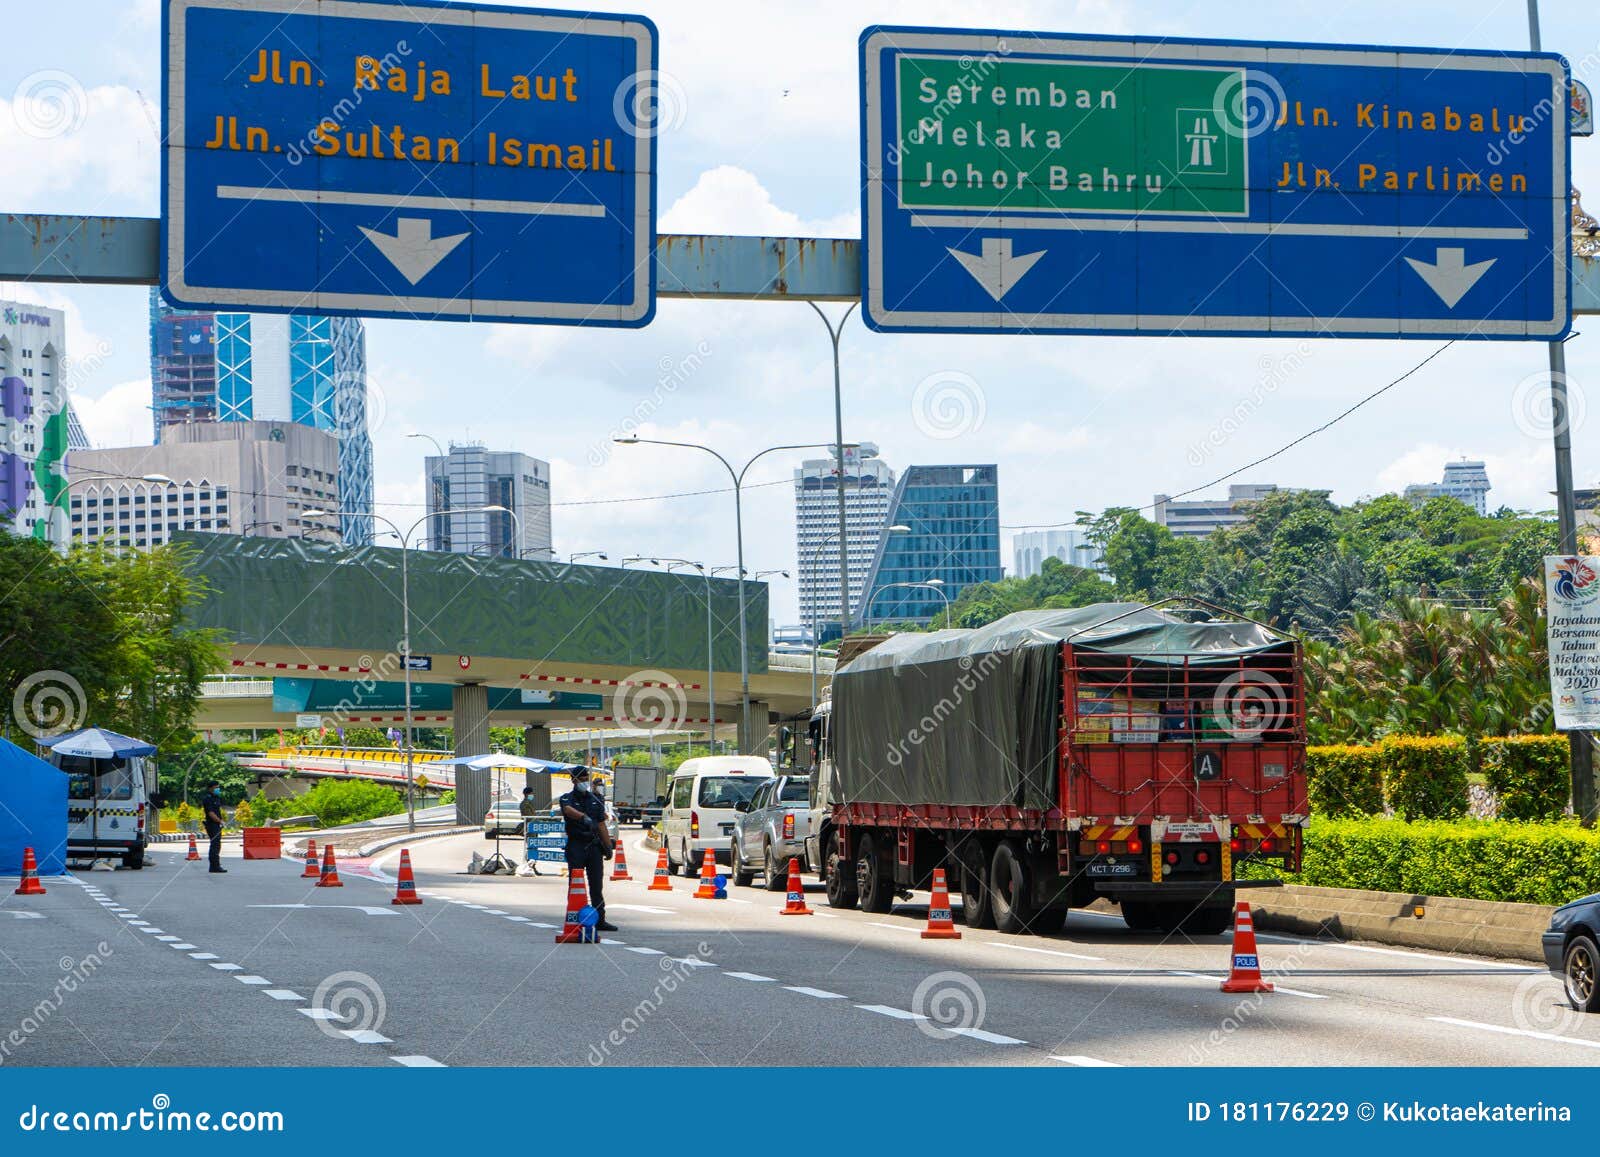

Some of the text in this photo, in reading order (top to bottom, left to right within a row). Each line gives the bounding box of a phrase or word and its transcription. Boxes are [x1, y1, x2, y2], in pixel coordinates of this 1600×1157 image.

[250, 50, 577, 102] Jln. Raja Laut
[919, 77, 1116, 109] Seremban
[1276, 101, 1524, 132] Jln. Kinabalu
[918, 120, 1061, 149] Melaka
[206, 115, 616, 171] Jln. Sultan Ismail
[919, 162, 1161, 193] Johor Bahru
[1277, 162, 1527, 192] Jln. Parlimen
[1550, 615, 1600, 628] Jayakan
[1560, 640, 1596, 651] Tahun
[1554, 652, 1600, 664] Melawa
[1563, 676, 1598, 689] 2020
[1199, 754, 1214, 775] A
[532, 823, 565, 832] BERHEN
[529, 838, 567, 848] PEMERIKSA
[538, 851, 565, 861] POLIS
[1091, 865, 1107, 873] KCT
[930, 910, 950, 919] POLIS
[1236, 957, 1256, 968] POLIS
